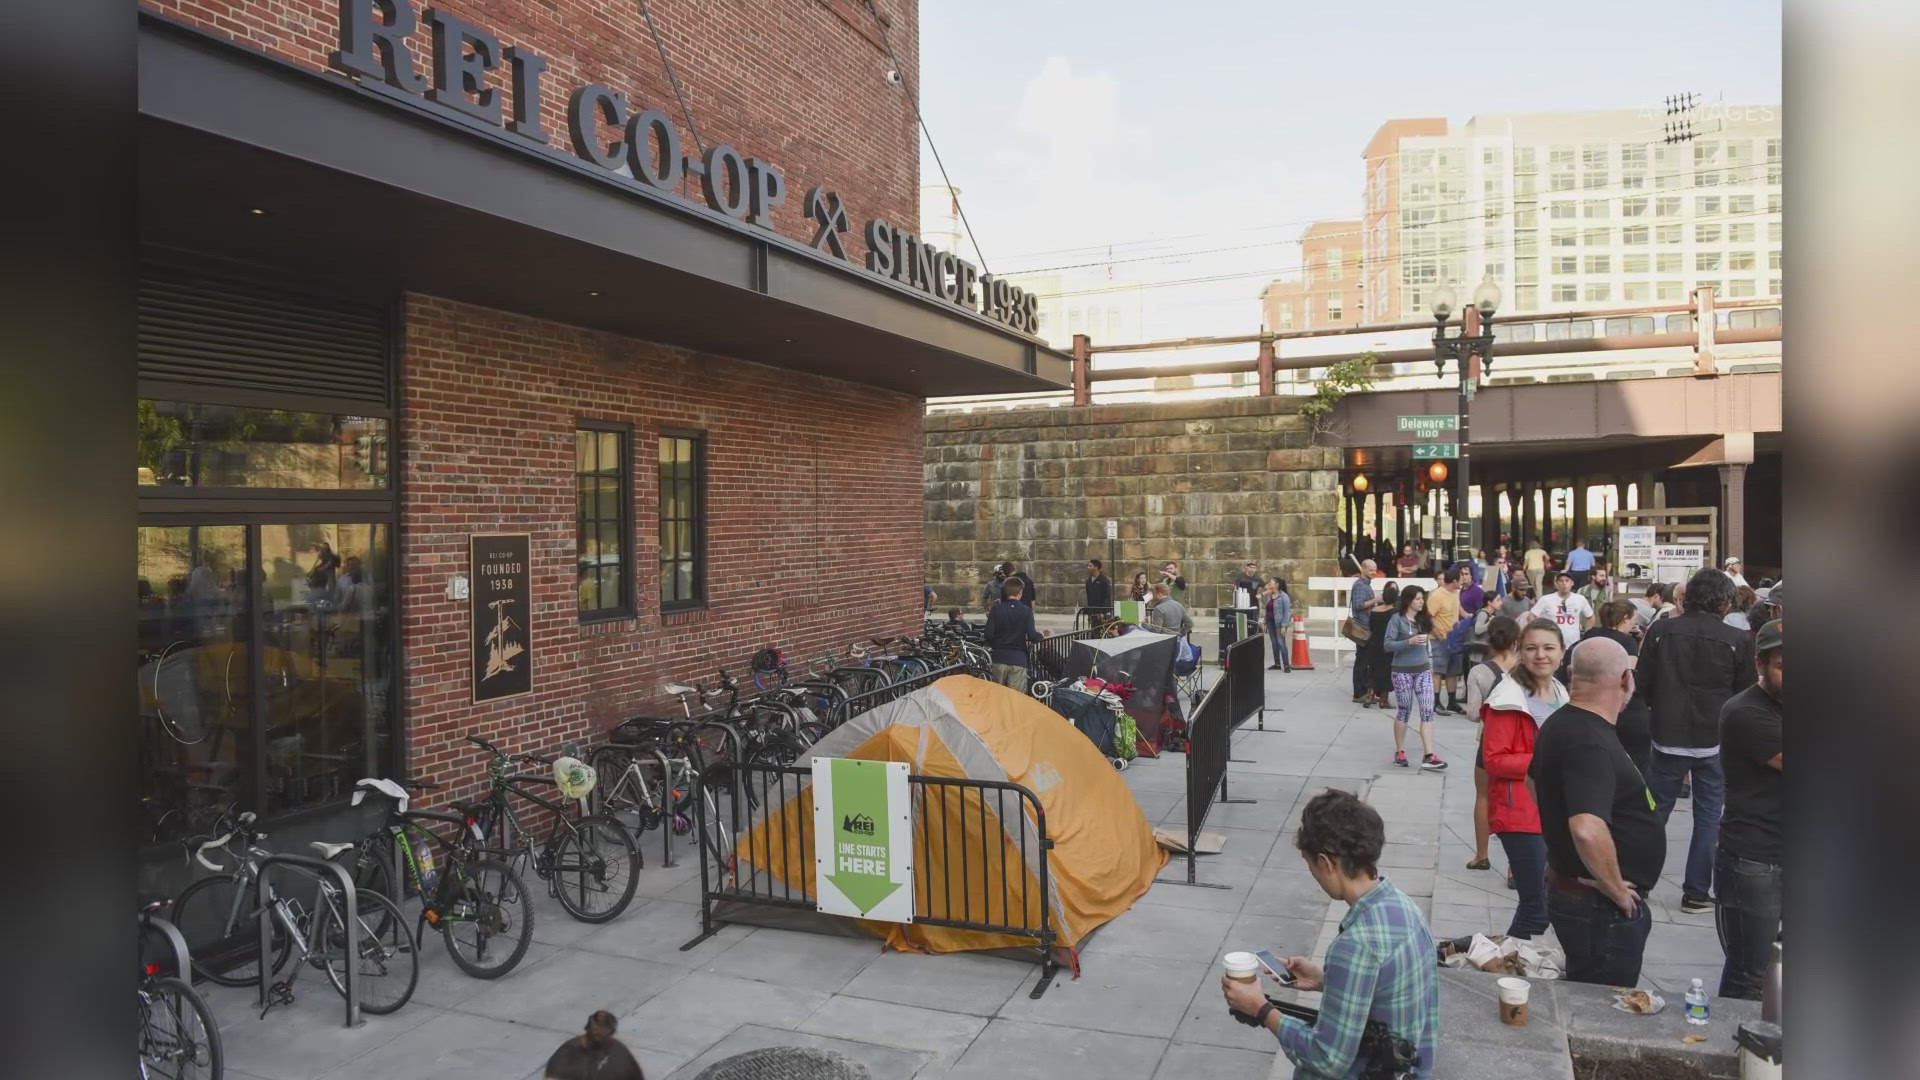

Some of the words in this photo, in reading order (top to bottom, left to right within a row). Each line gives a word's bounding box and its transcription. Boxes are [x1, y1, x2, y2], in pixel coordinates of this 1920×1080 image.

[332, 0, 550, 145] REI
[567, 83, 787, 232] CO-OP
[865, 217, 978, 314] SINCE
[979, 272, 1039, 336] 1938
[1401, 417, 1445, 429] Delaware
[1417, 430, 1439, 438] 1100
[1430, 446, 1438, 456] 2
[1664, 548, 1675, 556] YOU
[1675, 548, 1685, 556] ARE
[1686, 548, 1699, 556] HERE
[481, 562, 521, 576] FOUNDED
[490, 578, 513, 591] 1938
[1556, 616, 1574, 625] DC
[853, 821, 875, 832] REI
[839, 842, 855, 855] LINE
[857, 844, 886, 858] STARTS
[839, 856, 886, 876] HERE
